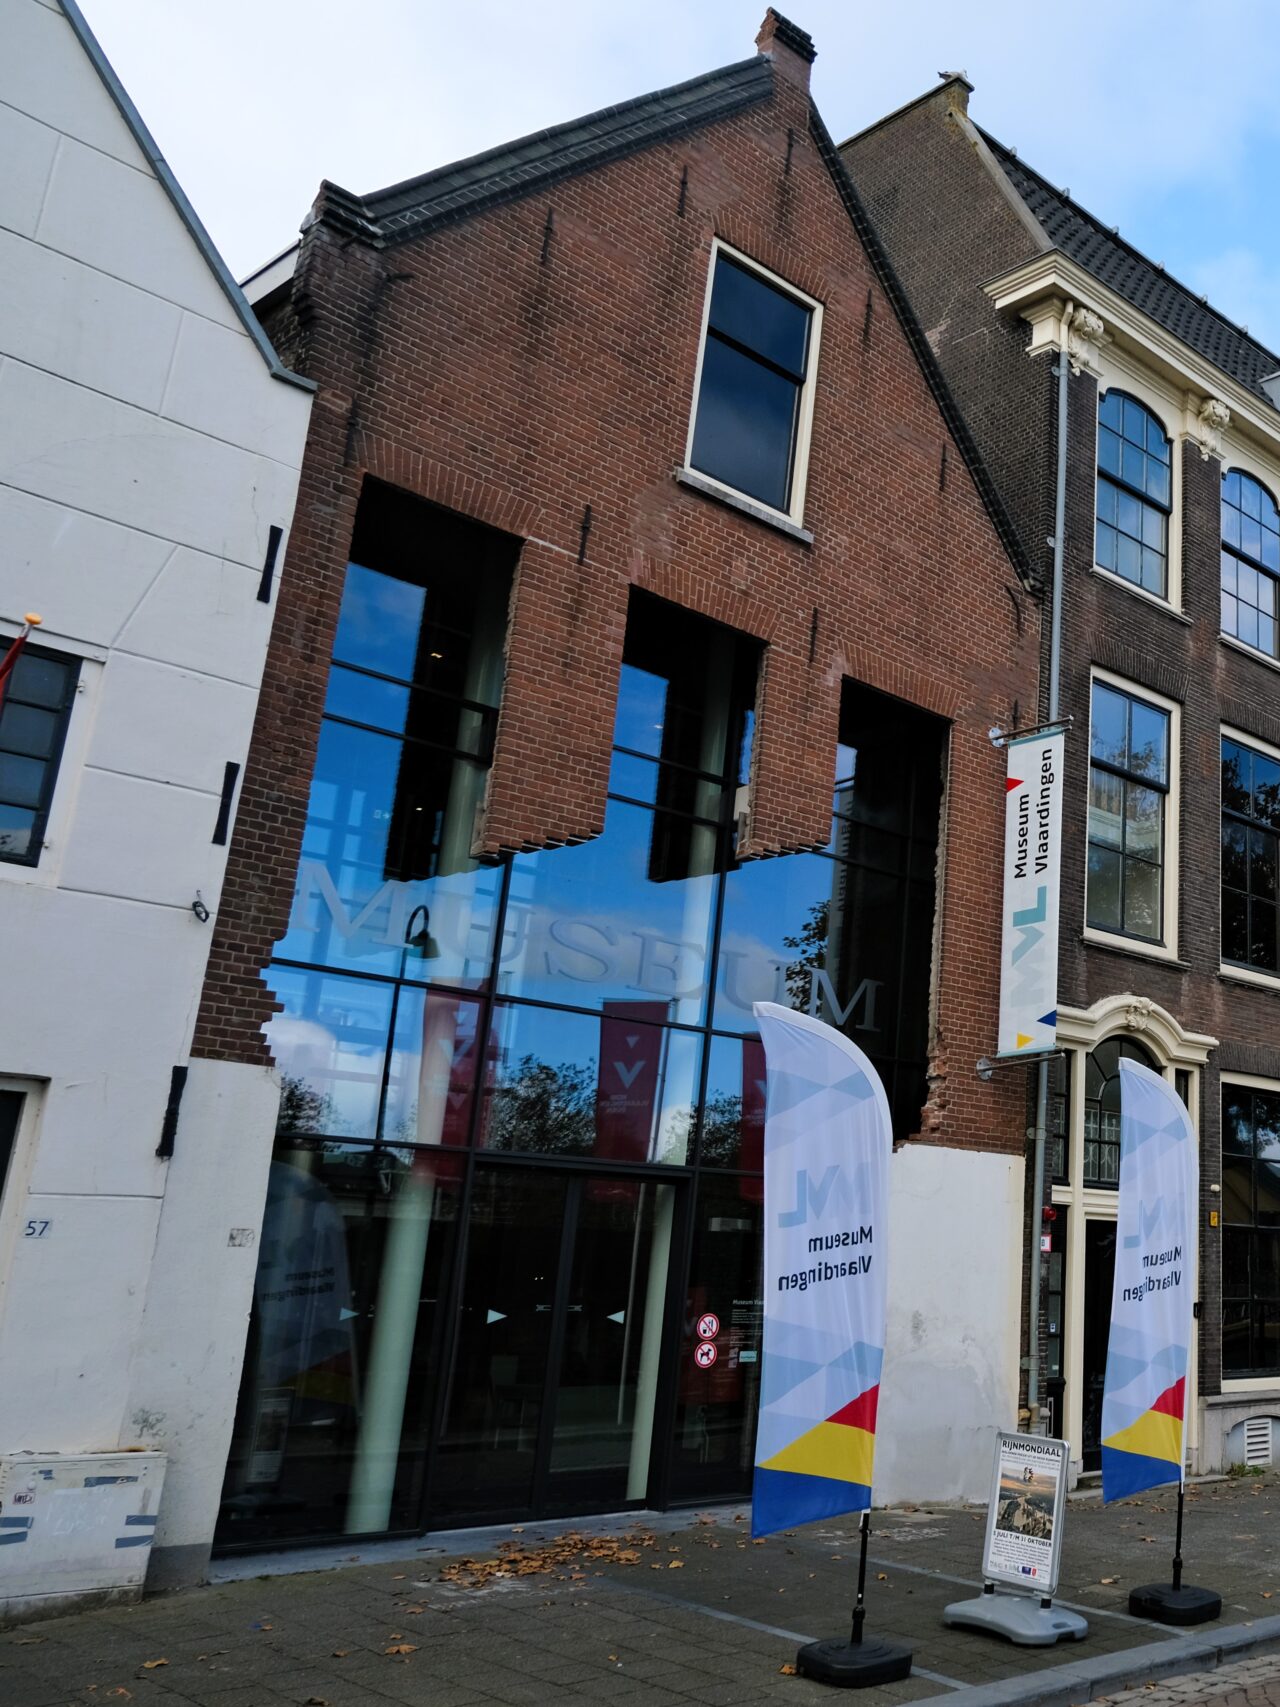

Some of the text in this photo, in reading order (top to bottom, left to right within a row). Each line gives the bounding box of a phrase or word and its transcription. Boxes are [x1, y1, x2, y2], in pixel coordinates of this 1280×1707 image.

[1013, 793, 1030, 879] Museum
[1034, 747, 1055, 875] Vlaardingen
[290, 861, 885, 1034] MUSEUM
[25, 1220, 50, 1237] 57
[1002, 1440, 1061, 1457] RIJNMONDIAAL
[1027, 1537, 1052, 1548] OKTOBER
